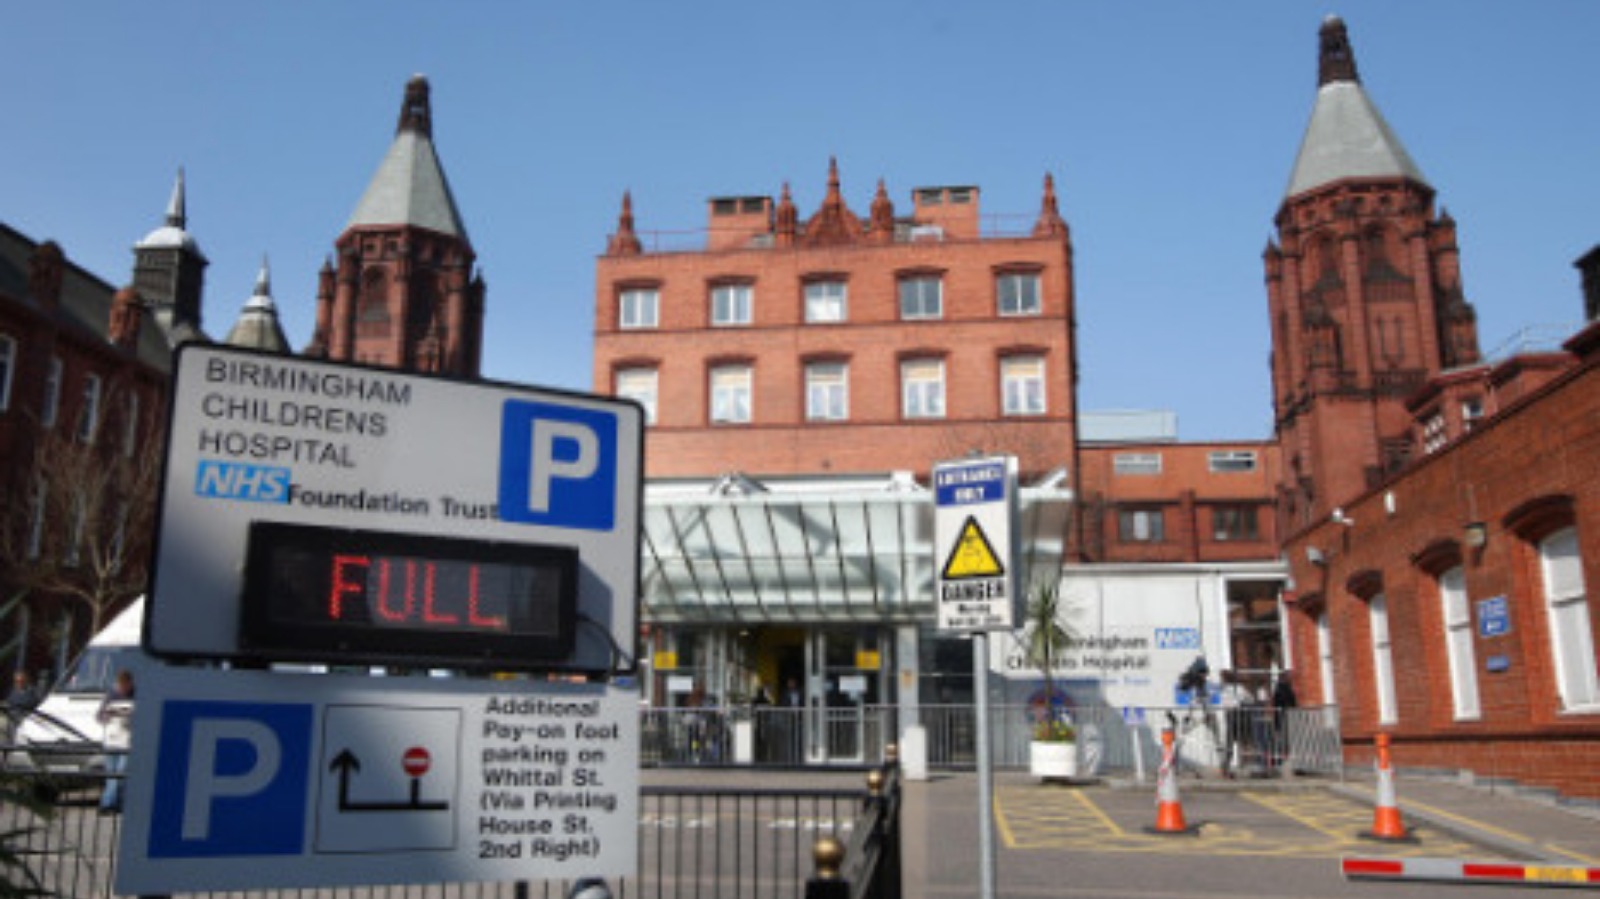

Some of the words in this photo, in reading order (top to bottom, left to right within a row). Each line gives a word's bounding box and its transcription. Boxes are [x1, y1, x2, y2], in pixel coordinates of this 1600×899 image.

[206, 357, 411, 405] BIRMINGHAM
[202, 394, 388, 437] CHILDRENS
[199, 429, 355, 468] HOSPITAL
[198, 462, 287, 501] NHS
[528, 418, 600, 514] P
[288, 483, 429, 516] Foundation
[441, 496, 499, 521] Trust
[329, 554, 503, 628] FULL
[942, 581, 1005, 601] DANGER
[486, 697, 599, 716] Additional
[483, 720, 565, 741] Pay-on
[575, 722, 618, 740] foot
[482, 746, 567, 766] parking
[578, 750, 605, 763] on
[181, 716, 282, 841] P
[483, 768, 563, 786] Whittal
[480, 791, 524, 811] (Via
[534, 791, 617, 813] Printing
[479, 816, 552, 835] House
[479, 839, 522, 859] 2nd
[531, 837, 600, 861] Right)
